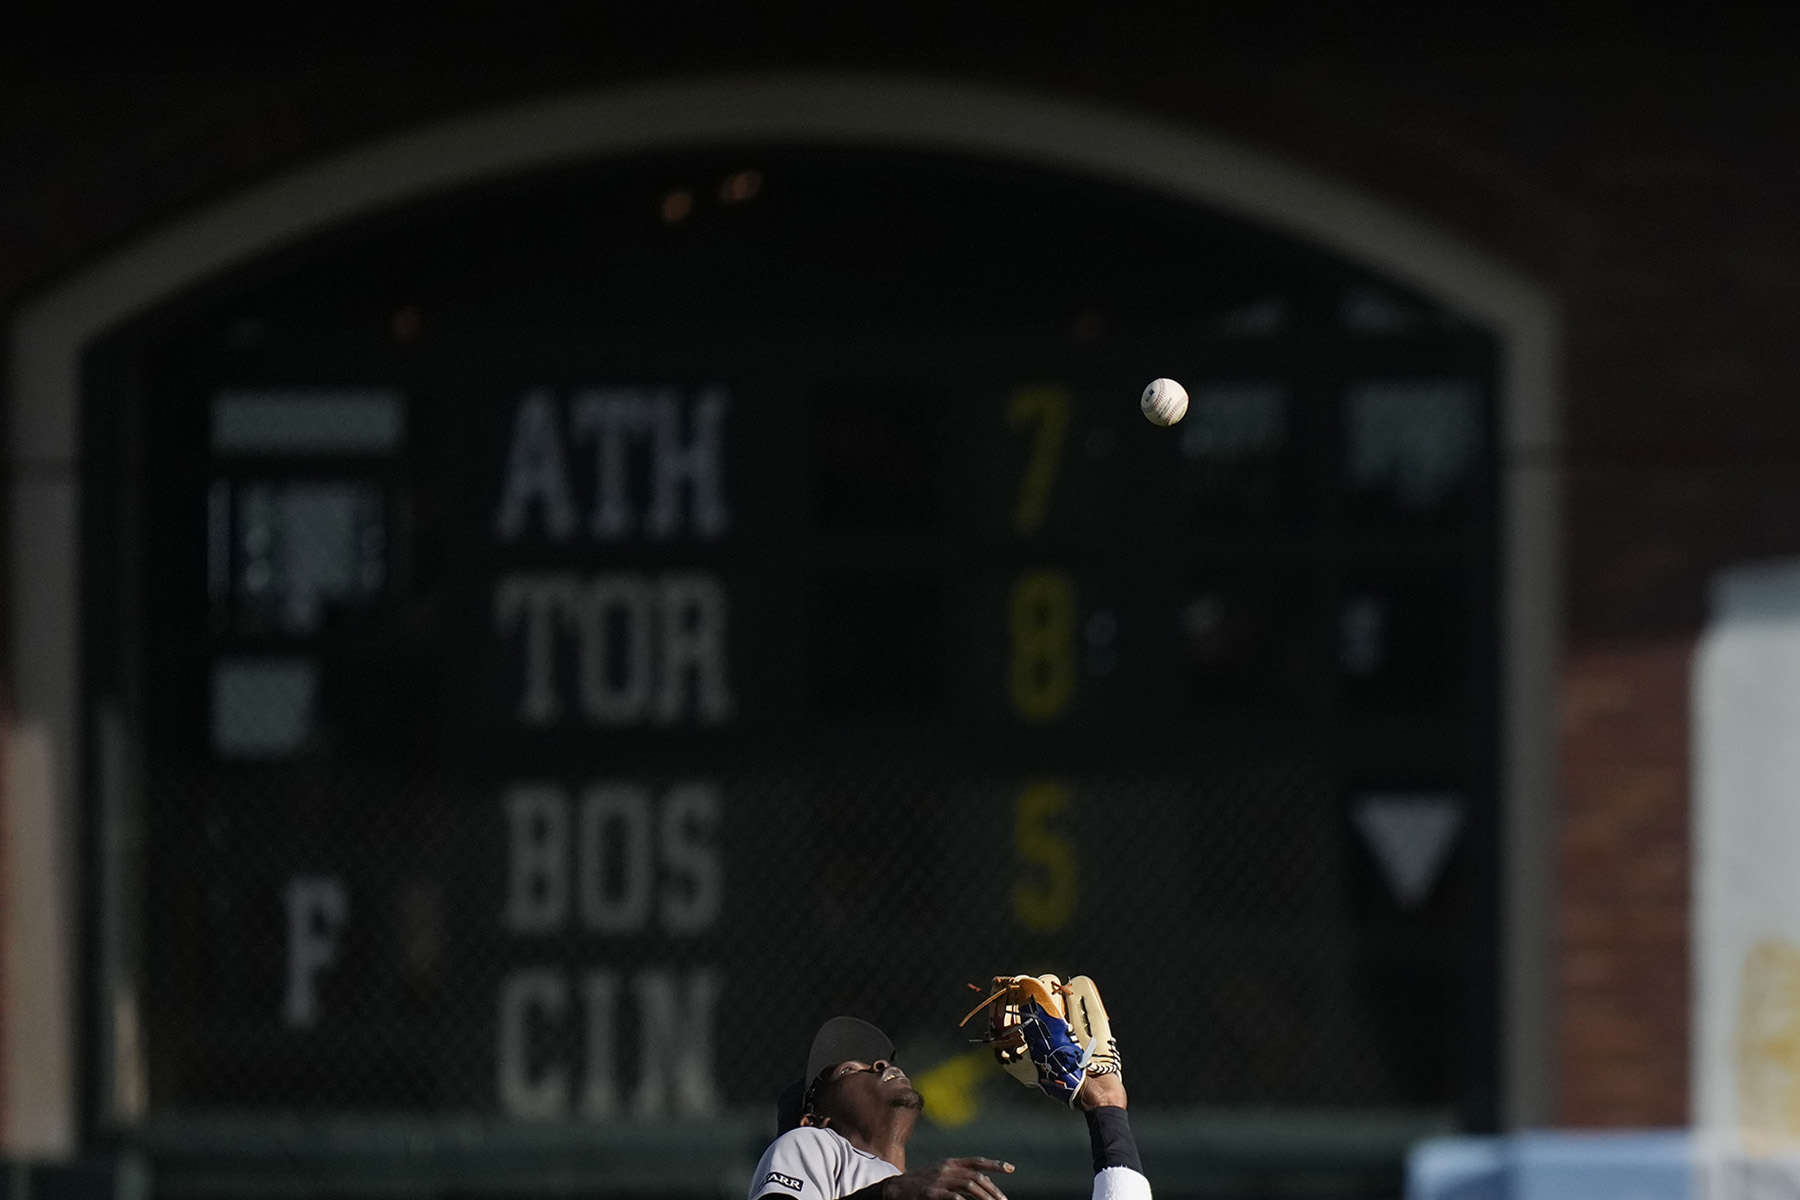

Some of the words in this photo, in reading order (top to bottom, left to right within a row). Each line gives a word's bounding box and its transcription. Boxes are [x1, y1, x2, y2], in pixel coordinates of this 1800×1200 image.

[494, 388, 730, 541] ATH
[1006, 384, 1073, 530] 7
[493, 572, 734, 725] TOR
[1008, 569, 1076, 722] 8
[502, 782, 724, 936] BOS
[1012, 780, 1079, 933] 5
[283, 875, 348, 1029] F
[496, 971, 726, 1116] CIN
